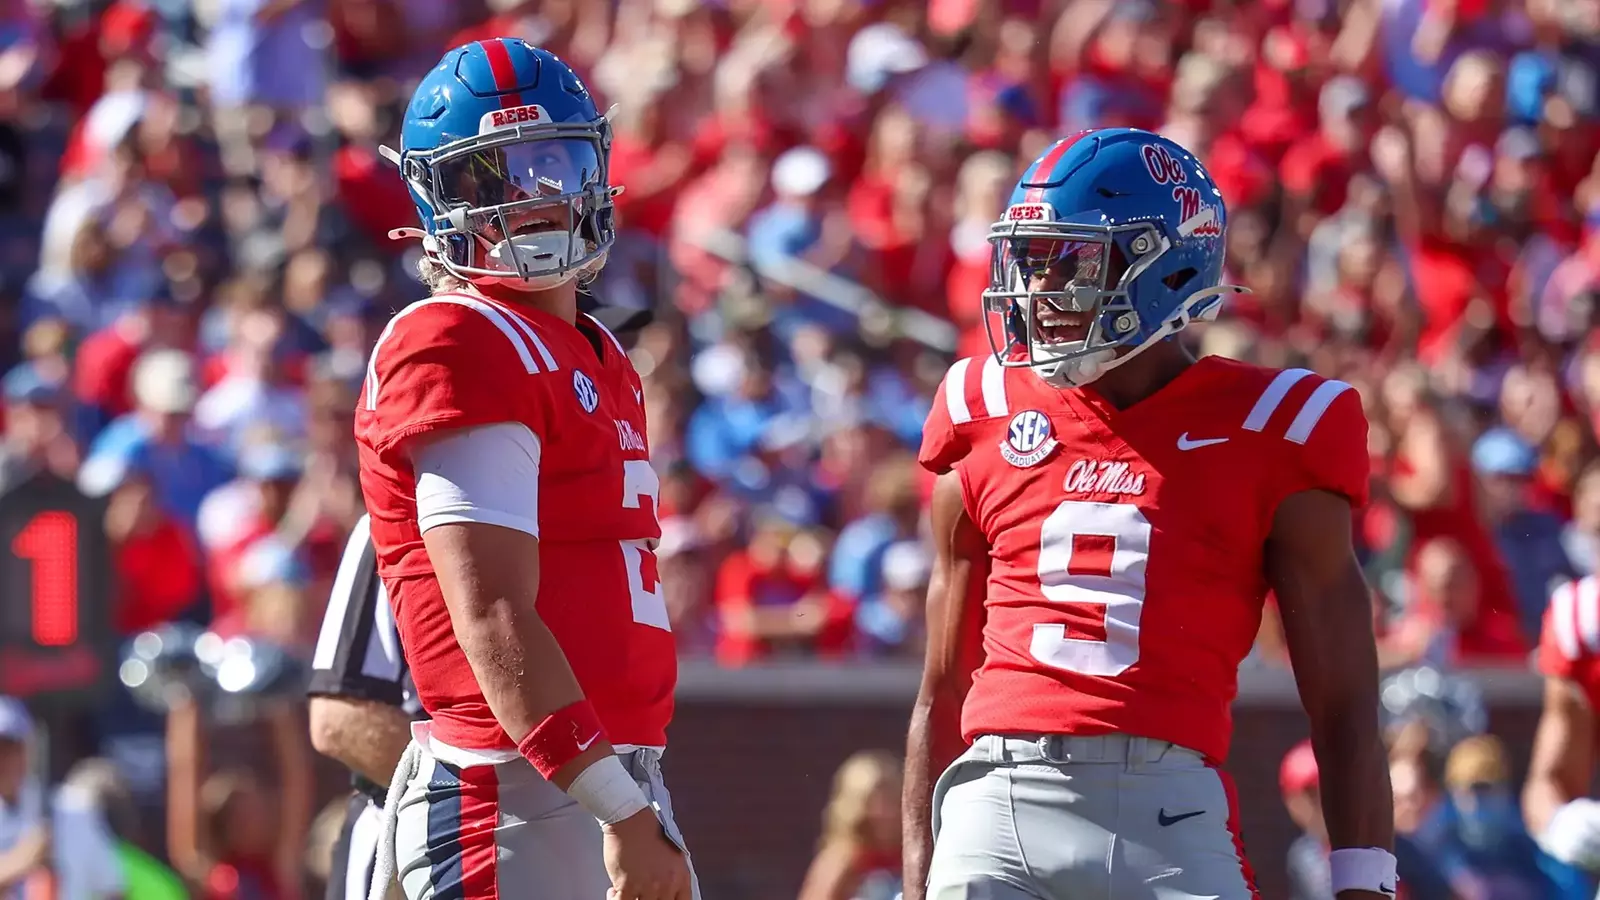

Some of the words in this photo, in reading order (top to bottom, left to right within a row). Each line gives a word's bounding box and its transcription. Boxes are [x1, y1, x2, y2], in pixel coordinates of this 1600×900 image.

[491, 106, 540, 127] REBS
[1142, 143, 1187, 185] Ole
[1009, 205, 1044, 221] REBS
[573, 369, 598, 413] SEC
[1010, 411, 1048, 452] SEC
[1003, 448, 1048, 466] GRADUATE
[1064, 459, 1099, 493] Ole
[1095, 459, 1146, 495] Miss
[620, 460, 672, 632] 2
[11, 511, 77, 646] 1
[1029, 501, 1152, 677] 9
